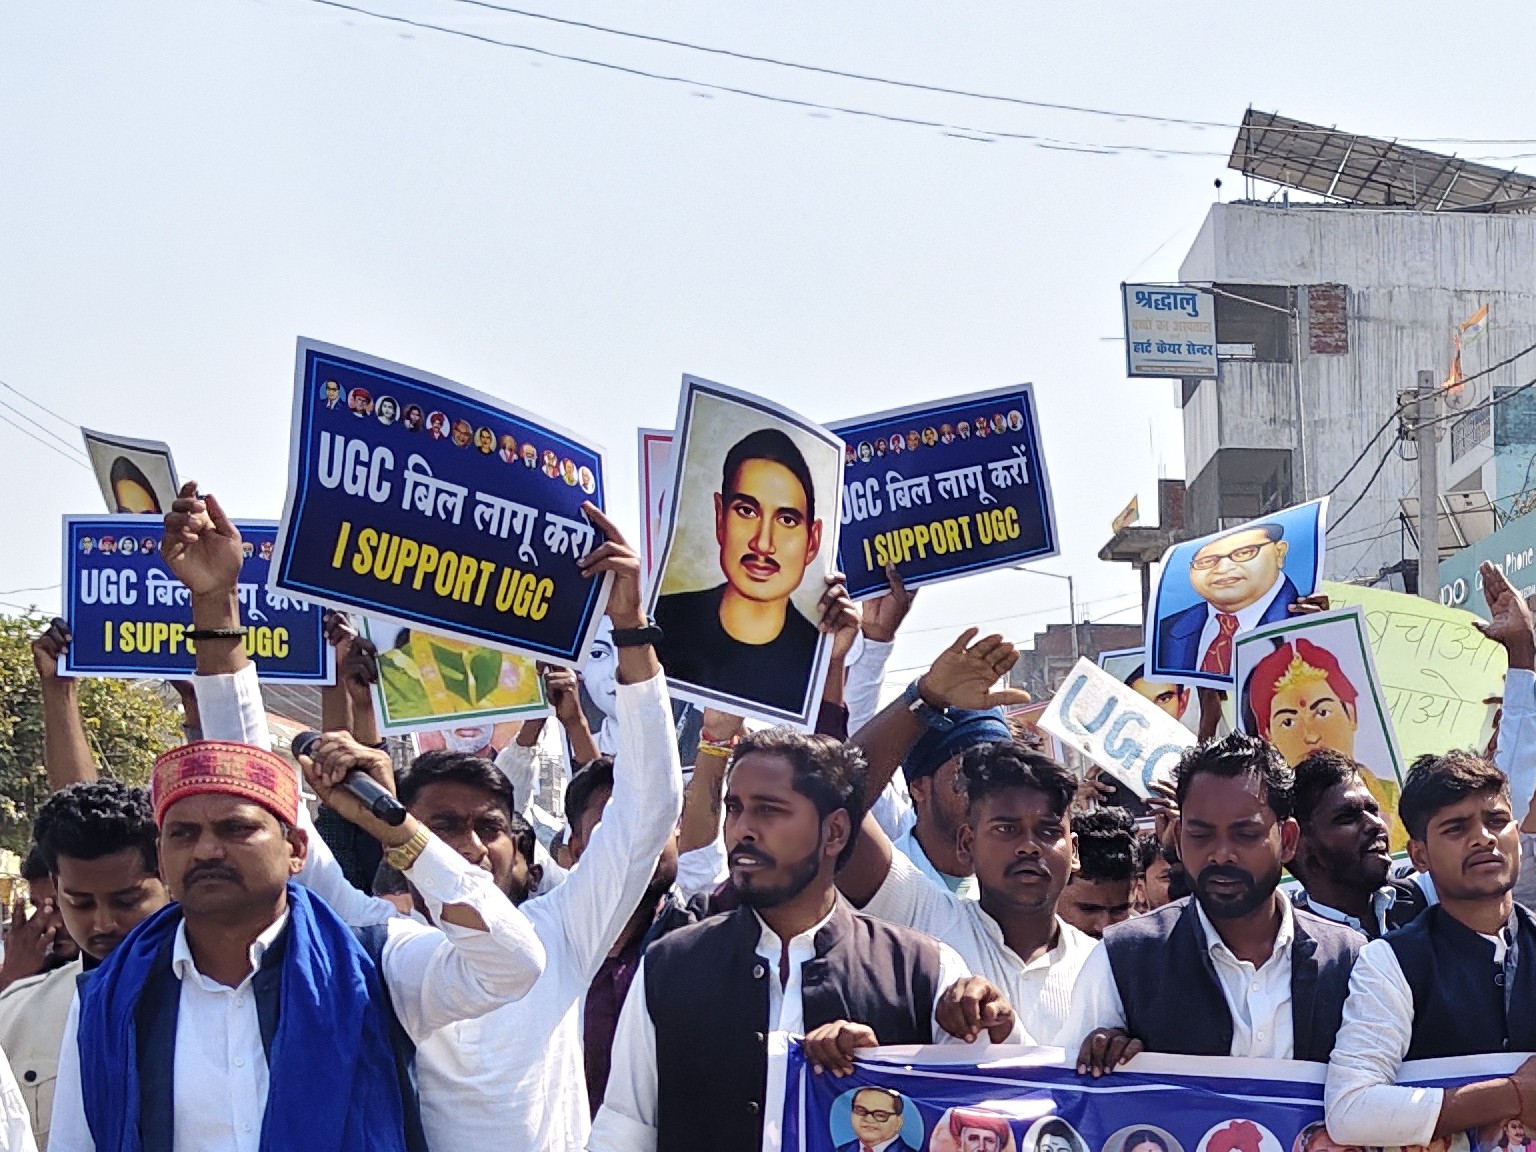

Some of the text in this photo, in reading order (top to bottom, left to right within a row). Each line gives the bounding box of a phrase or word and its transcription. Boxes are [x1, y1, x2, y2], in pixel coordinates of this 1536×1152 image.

[1135, 291, 1199, 317] श्रद्धालु
[1132, 339, 1152, 353] हार्ट
[1155, 340, 1182, 354] केयर
[886, 471, 932, 512] बिल
[934, 465, 997, 505] लागू
[988, 444, 1029, 489] करों
[318, 432, 394, 502] UGC
[402, 454, 468, 525] बिल
[473, 492, 538, 566] लागू
[863, 506, 1020, 571] I SUPPORT UGC
[332, 522, 554, 621] I SUPPORT UGC
[1506, 548, 1534, 576] Phone
[80, 568, 138, 605] UGC
[105, 621, 112, 652] I
